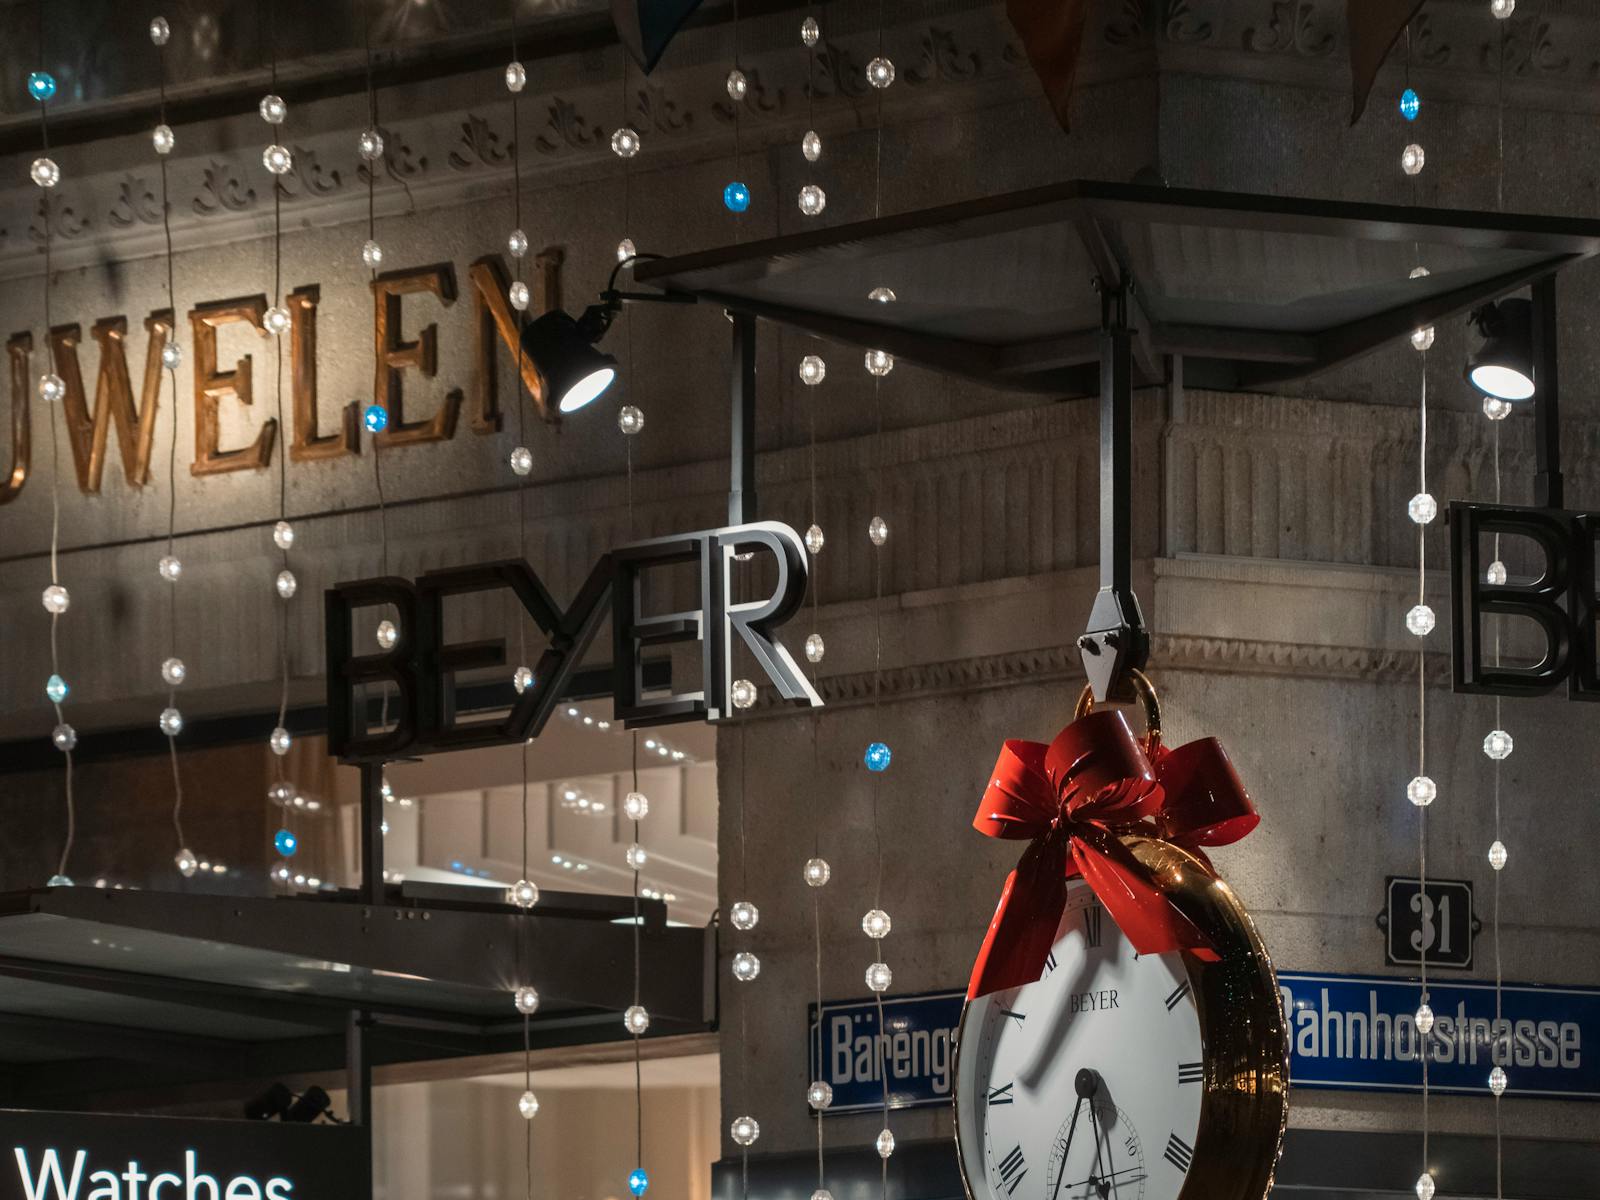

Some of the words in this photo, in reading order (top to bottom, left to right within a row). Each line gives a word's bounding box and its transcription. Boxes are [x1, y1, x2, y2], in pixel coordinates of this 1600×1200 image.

[325, 521, 826, 765] BEYER
[1410, 893, 1452, 953] 31
[1070, 989, 1120, 1014] BEYER
